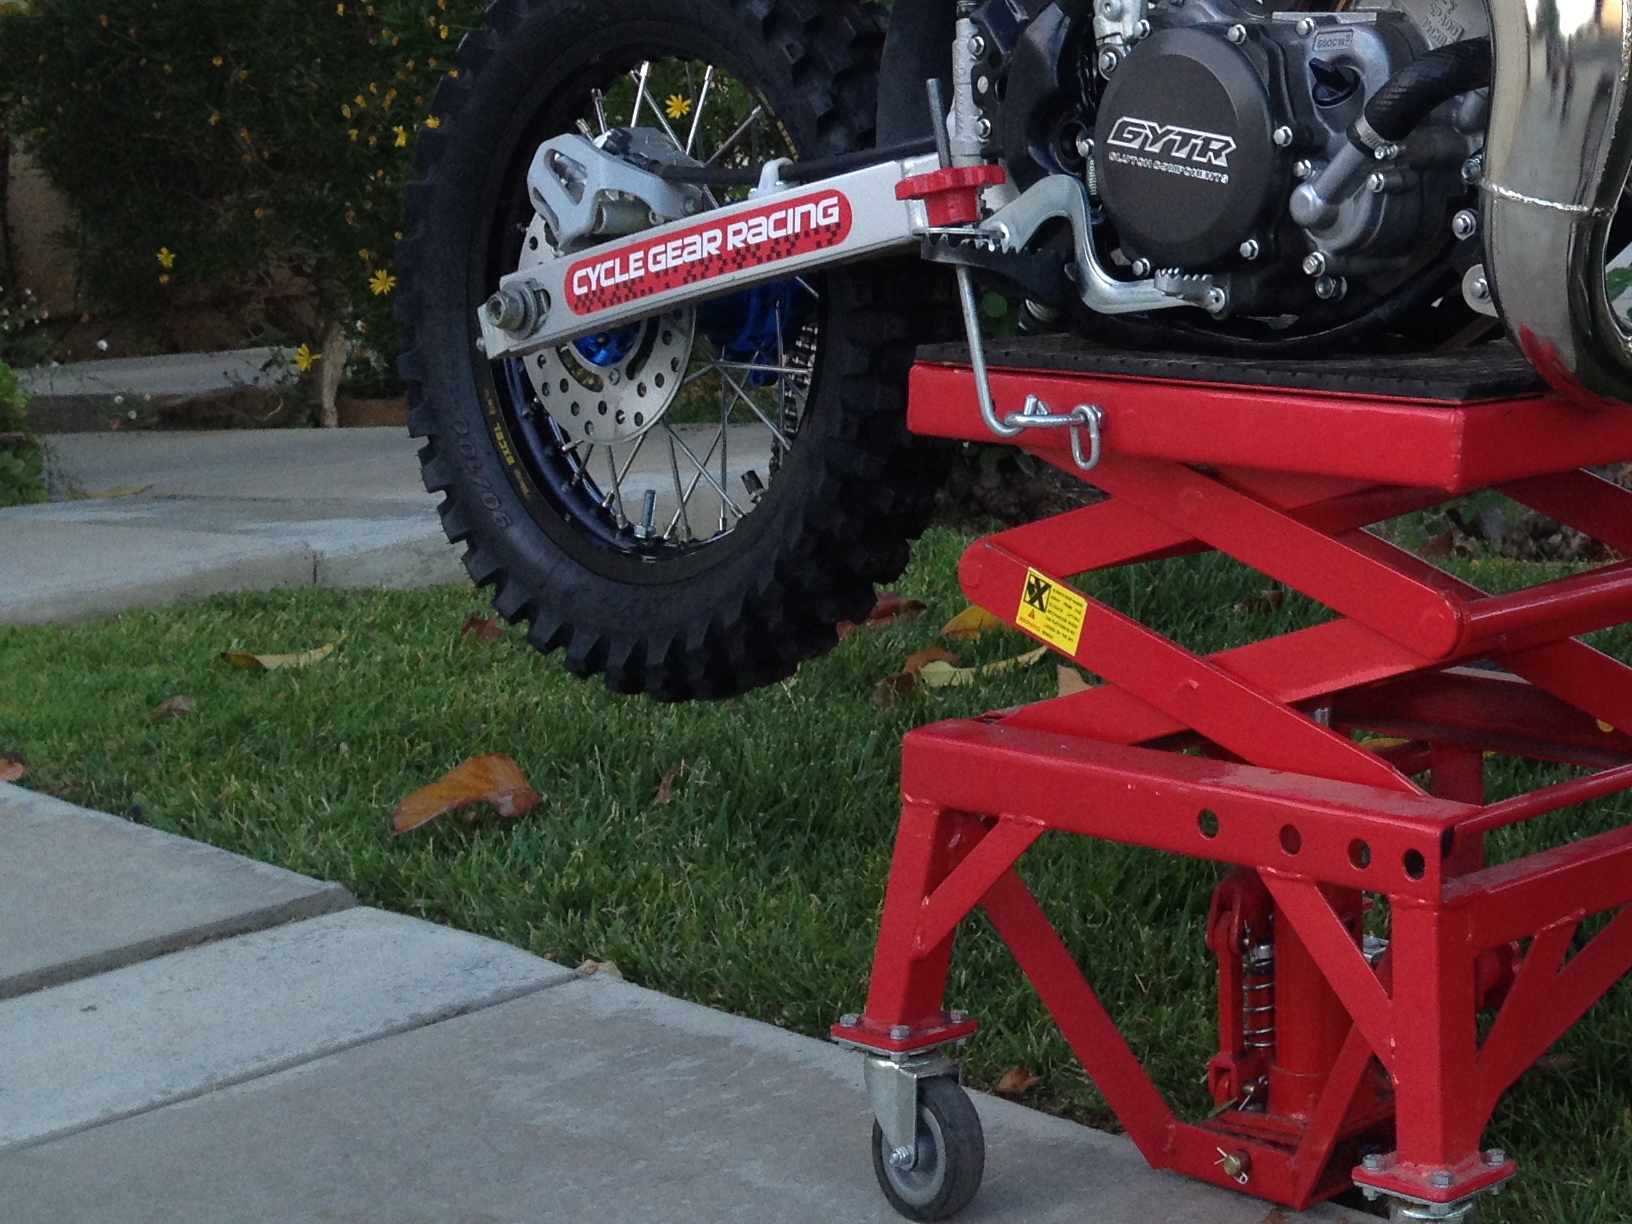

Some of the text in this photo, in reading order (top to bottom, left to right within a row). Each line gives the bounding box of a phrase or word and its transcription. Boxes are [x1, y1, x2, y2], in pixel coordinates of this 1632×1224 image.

[1106, 116, 1238, 167] GYTR
[1108, 151, 1230, 184] CLUTCH COMPONENTS
[572, 251, 646, 296] CYCLE
[647, 228, 723, 273] GEAR
